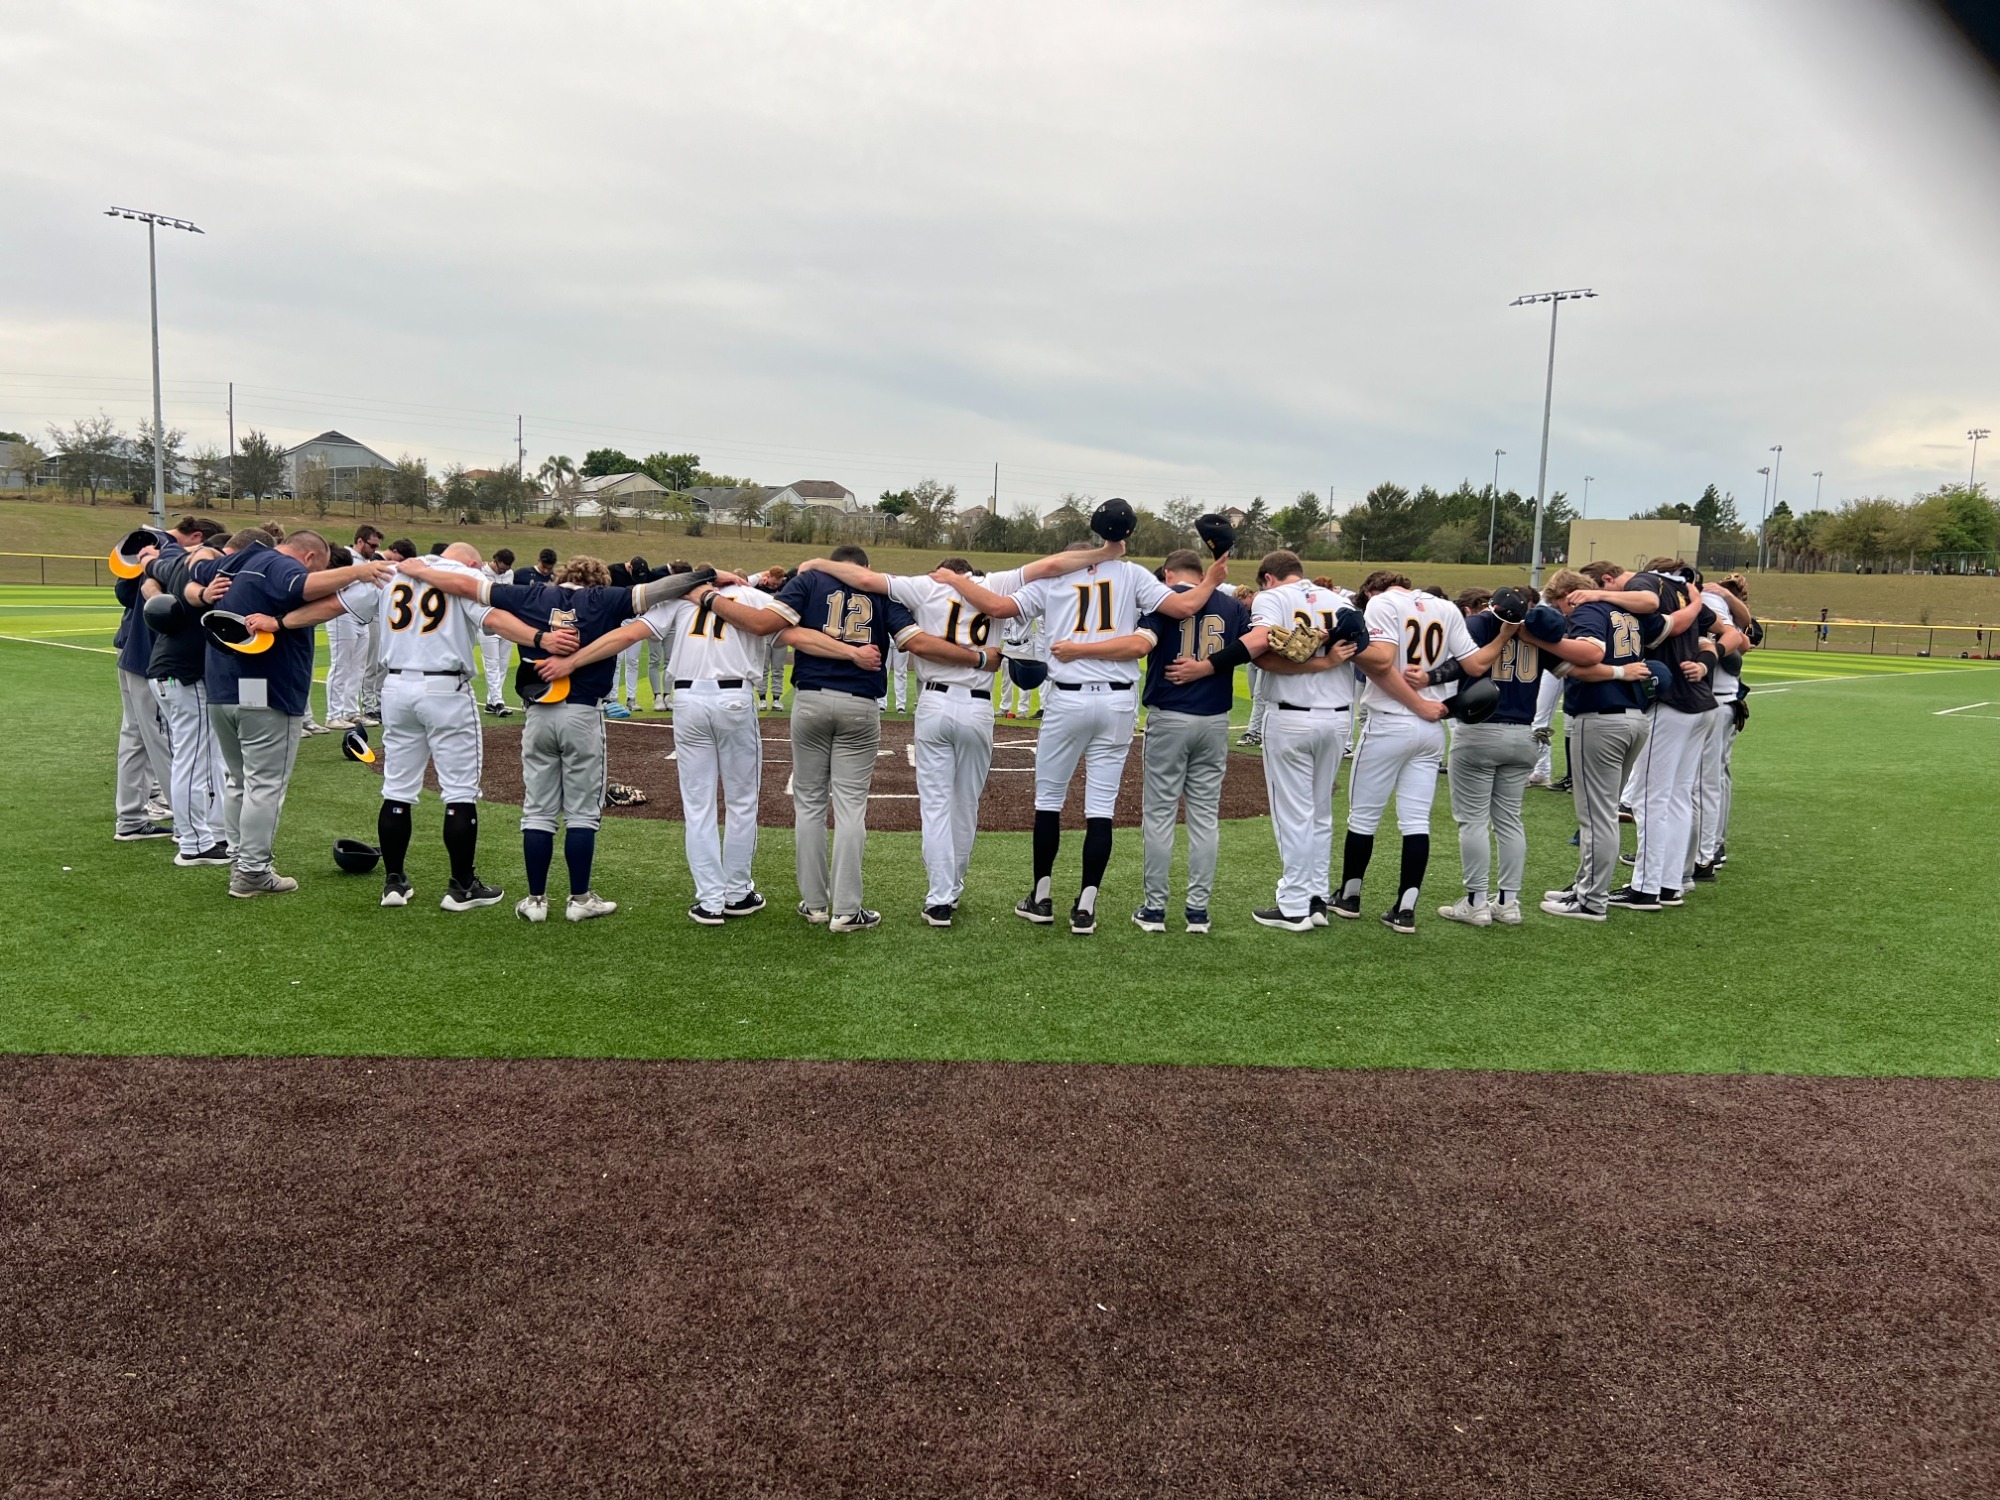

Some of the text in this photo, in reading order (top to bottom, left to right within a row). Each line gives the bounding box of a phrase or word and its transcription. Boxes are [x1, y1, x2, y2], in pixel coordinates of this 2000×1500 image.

[387, 581, 448, 635] 39
[823, 590, 873, 643] 12
[944, 598, 991, 648] 16
[1072, 579, 1115, 633] 11
[1177, 614, 1225, 662] 16
[1405, 616, 1444, 667] 20
[1491, 638, 1539, 683] 20
